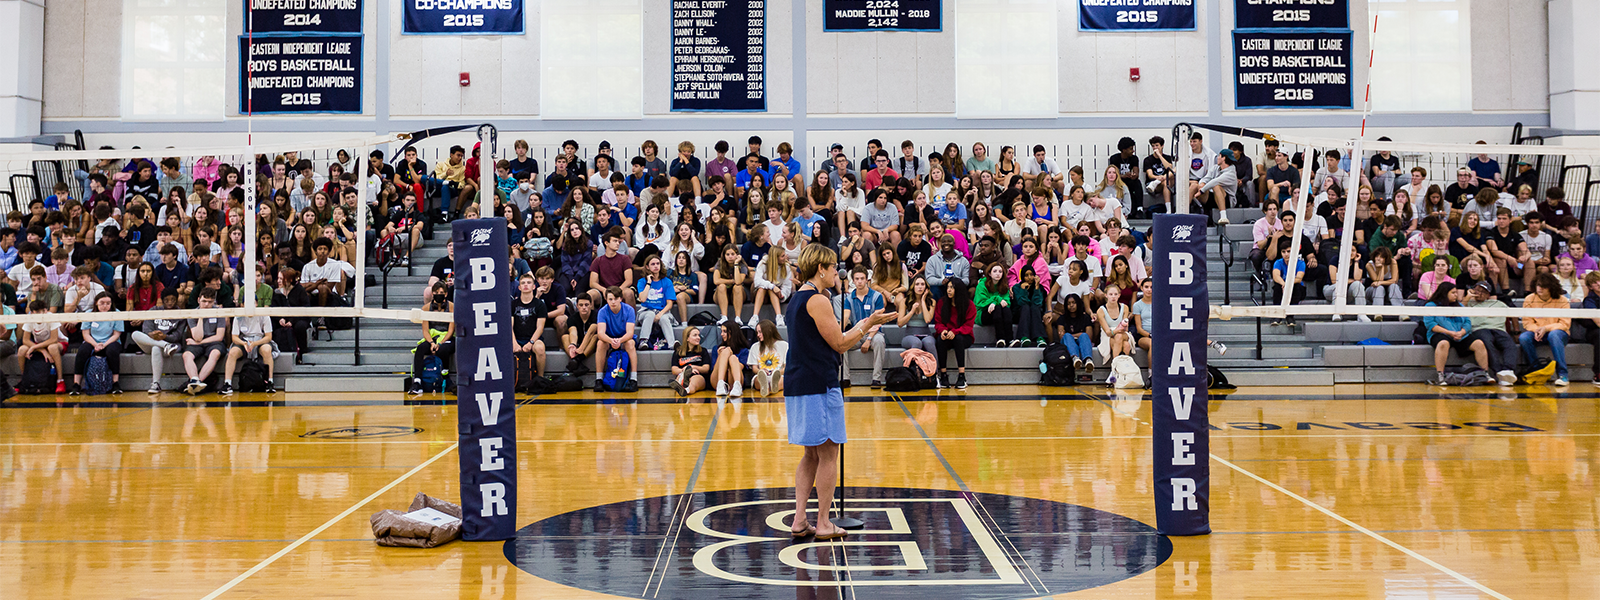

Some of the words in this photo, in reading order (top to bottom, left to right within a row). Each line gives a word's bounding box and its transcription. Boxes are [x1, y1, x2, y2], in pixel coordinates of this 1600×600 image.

[251, 0, 306, 10] UNDEFEATED
[309, 0, 356, 10] CHAMPIONS
[674, 1, 700, 9] RACHAEL
[747, 1, 763, 9] 2000
[866, 1, 900, 9] 2,024
[674, 10, 690, 18] ZACH
[747, 10, 763, 18] 2000
[835, 10, 866, 18] MADDIE
[868, 10, 899, 18] MULLIN
[908, 10, 931, 18] 2018
[1116, 11, 1158, 23] 2015
[1272, 10, 1311, 22] 2015
[283, 14, 321, 26] 2014
[443, 15, 483, 27] 2015
[674, 19, 694, 27] DANNY
[747, 19, 763, 27] 2002
[867, 19, 899, 28] 2,142
[674, 28, 694, 36] DANNY
[747, 28, 763, 36] 2002
[675, 37, 694, 45] AARON
[747, 37, 763, 45] 2004
[1241, 39, 1271, 51] EASTERN
[1273, 39, 1315, 51] INDEPENDENT
[1318, 39, 1343, 51] LEAGUE
[251, 43, 280, 56] EASTERN
[282, 43, 324, 55] INDEPENDENT
[326, 42, 352, 55] LEAGUE
[674, 46, 693, 54] PETER
[747, 46, 763, 54] 2007
[675, 55, 698, 63] EPHRAIM
[747, 55, 763, 63] 2008
[1239, 56, 1269, 68] BOYS
[1272, 56, 1346, 68] BASKETBALL
[247, 60, 277, 72] BOYS
[281, 59, 355, 72] BASKETBALL
[675, 64, 702, 72] JHERSON
[747, 64, 763, 72] 2013
[674, 73, 706, 81] STEPHANIE
[747, 73, 763, 81] 2014
[1239, 73, 1296, 85] UNDEFEATED
[1298, 73, 1347, 85] CHAMPIONS
[247, 77, 303, 89] UNDEFEATED
[306, 76, 355, 88] CHAMPIONS
[674, 82, 689, 90] JEFF
[690, 82, 723, 90] SPELLMAN
[747, 82, 763, 90] 2014
[281, 93, 322, 105] 2015
[674, 91, 696, 100] MADDIE
[697, 91, 720, 100] MULLIN
[747, 91, 763, 100] 2017
[1273, 89, 1314, 101] 2016
[1167, 251, 1199, 512] BEAVER
[469, 256, 511, 519] BEAVER
